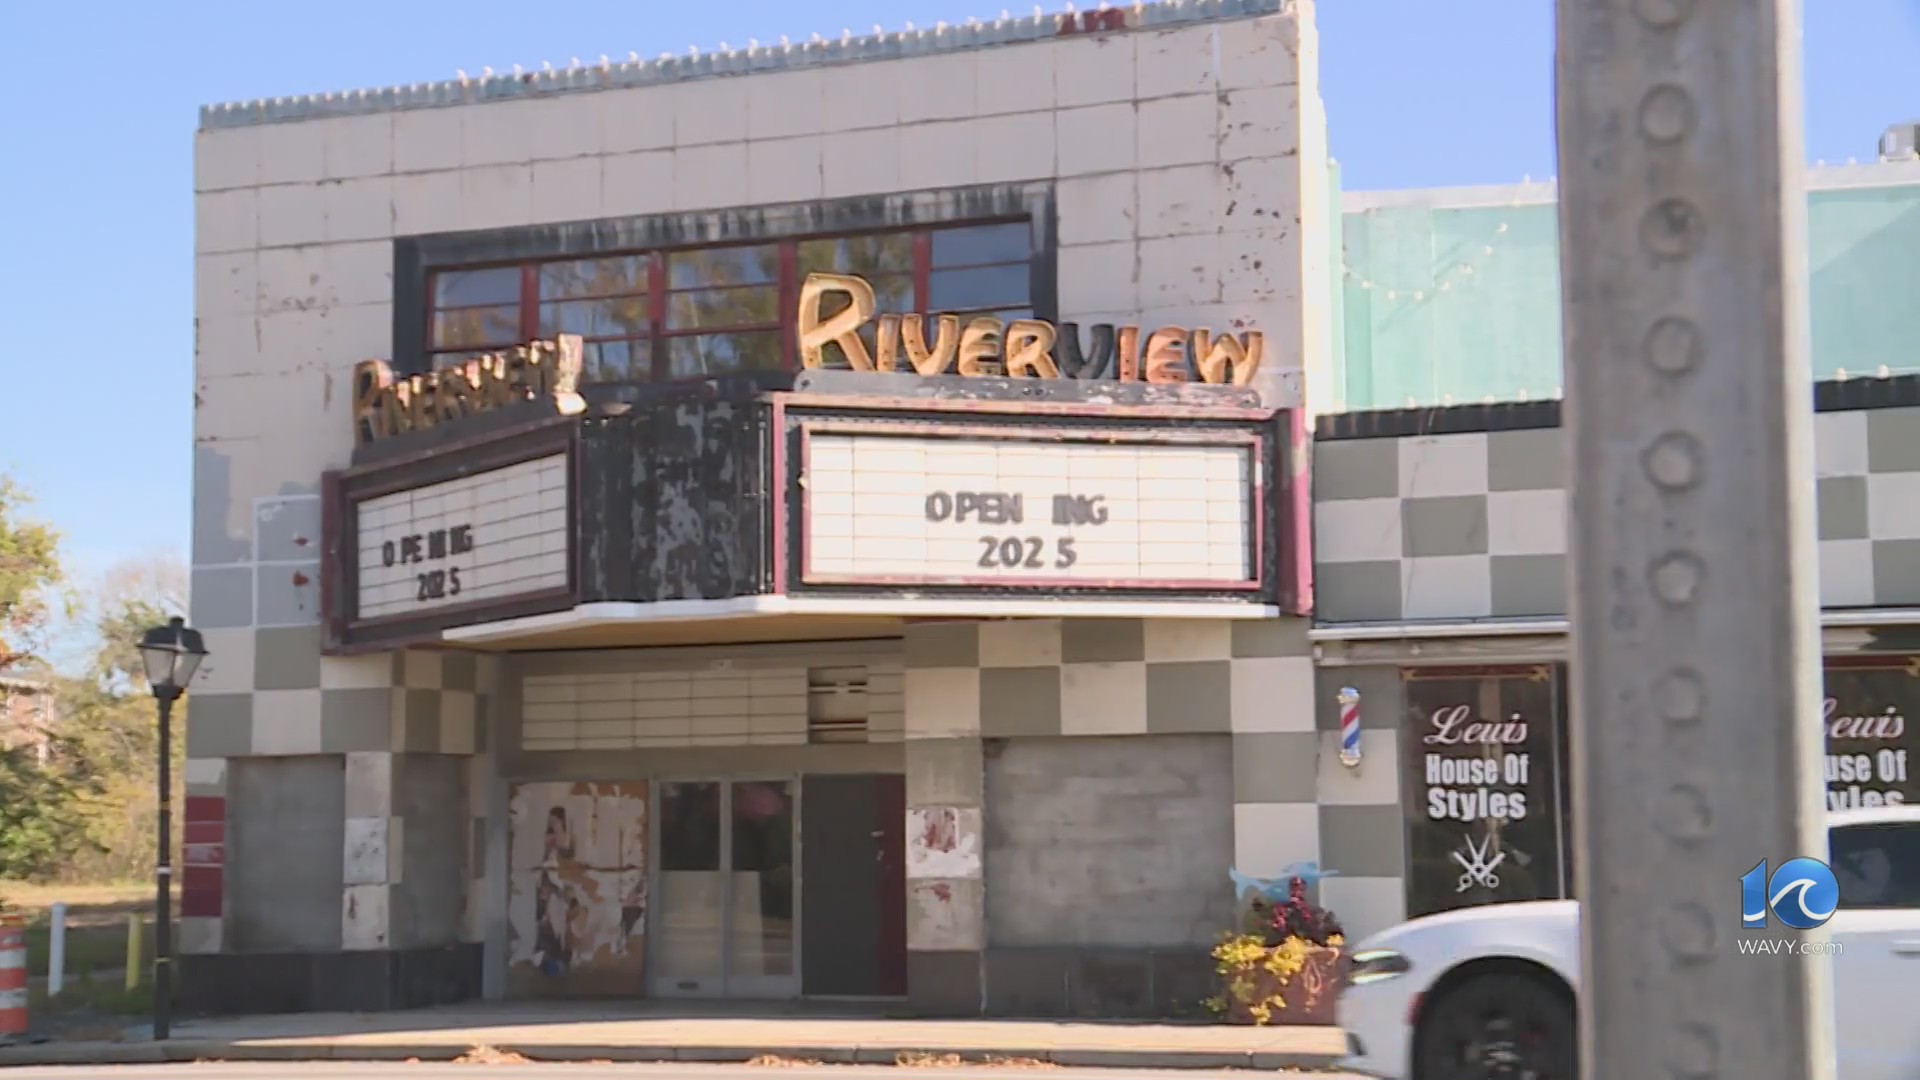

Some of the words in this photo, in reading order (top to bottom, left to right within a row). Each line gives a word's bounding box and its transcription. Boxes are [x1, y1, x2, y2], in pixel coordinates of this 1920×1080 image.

[798, 272, 1263, 386] RIVERVIEW
[1423, 704, 1528, 744] Lewis
[1426, 753, 1498, 785] House
[1504, 753, 1529, 785] Of
[1824, 753, 1872, 783] use
[1878, 748, 1907, 783] Of
[1427, 787, 1526, 822] Styles
